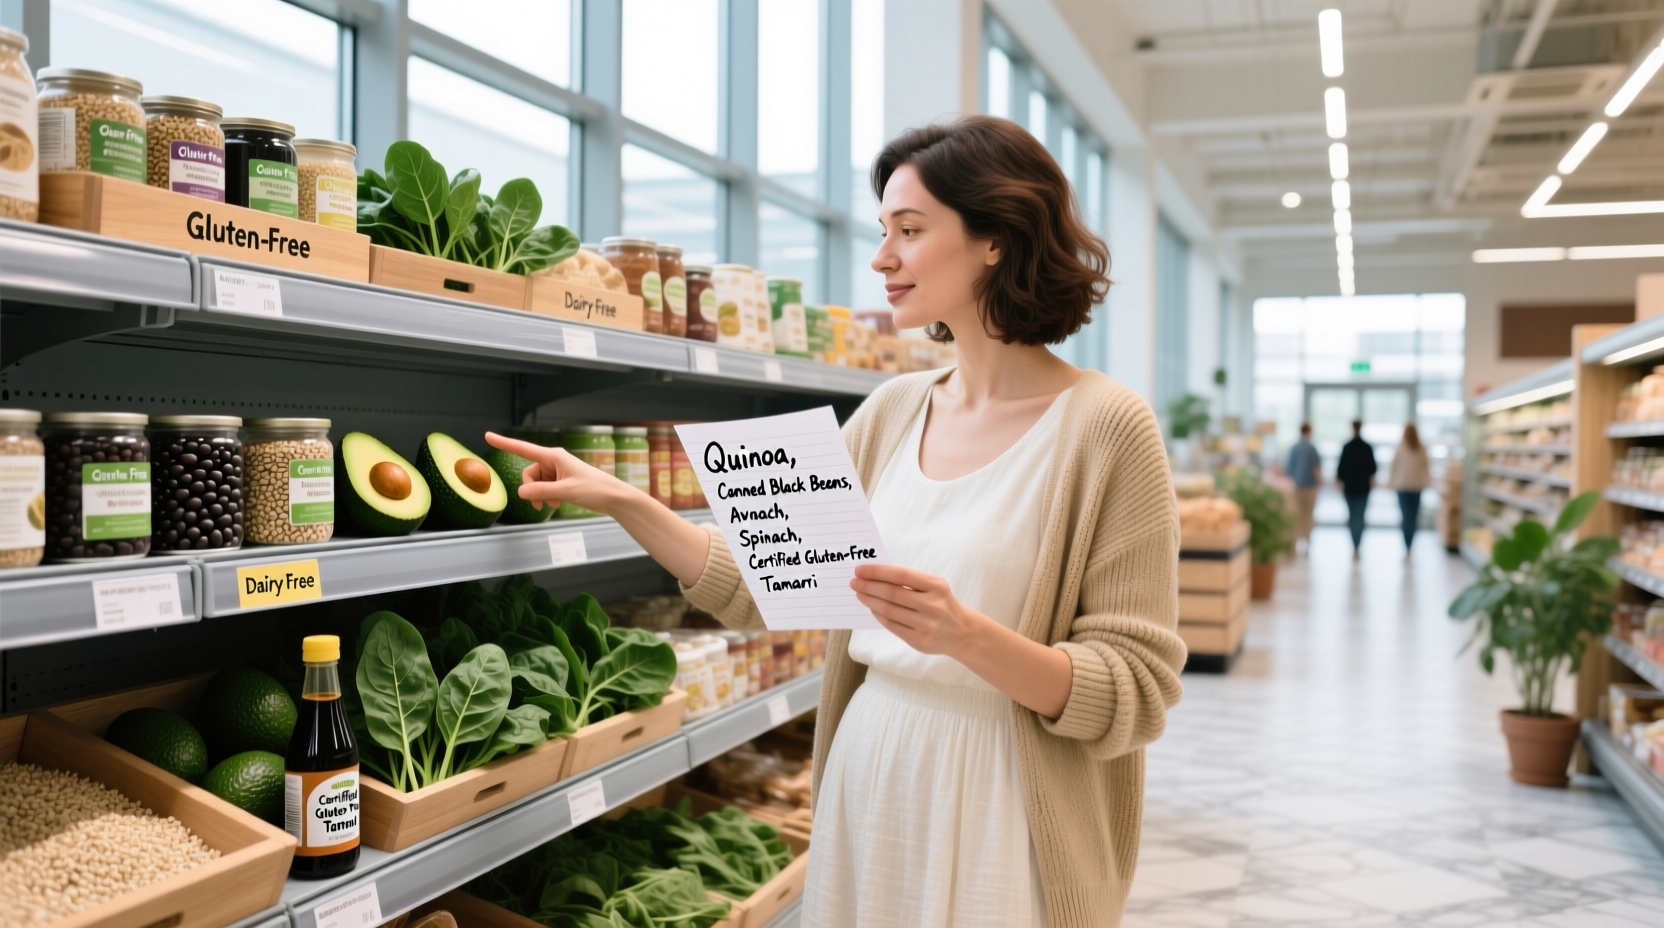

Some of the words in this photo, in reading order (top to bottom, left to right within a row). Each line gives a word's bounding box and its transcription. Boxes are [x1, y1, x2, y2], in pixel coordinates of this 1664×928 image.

[186, 211, 310, 259] Gluten-Free
[565, 291, 593, 319] Dairy
[595, 298, 616, 318] Free
[704, 441, 796, 473] Quinoa,
[769, 476, 806, 495] Black
[730, 503, 789, 523] Avnach,
[739, 527, 802, 551] Spinach,
[749, 551, 801, 569] Certified
[805, 545, 877, 564] Gluten-Free
[245, 575, 284, 597] Dairy
[285, 573, 315, 590] Free
